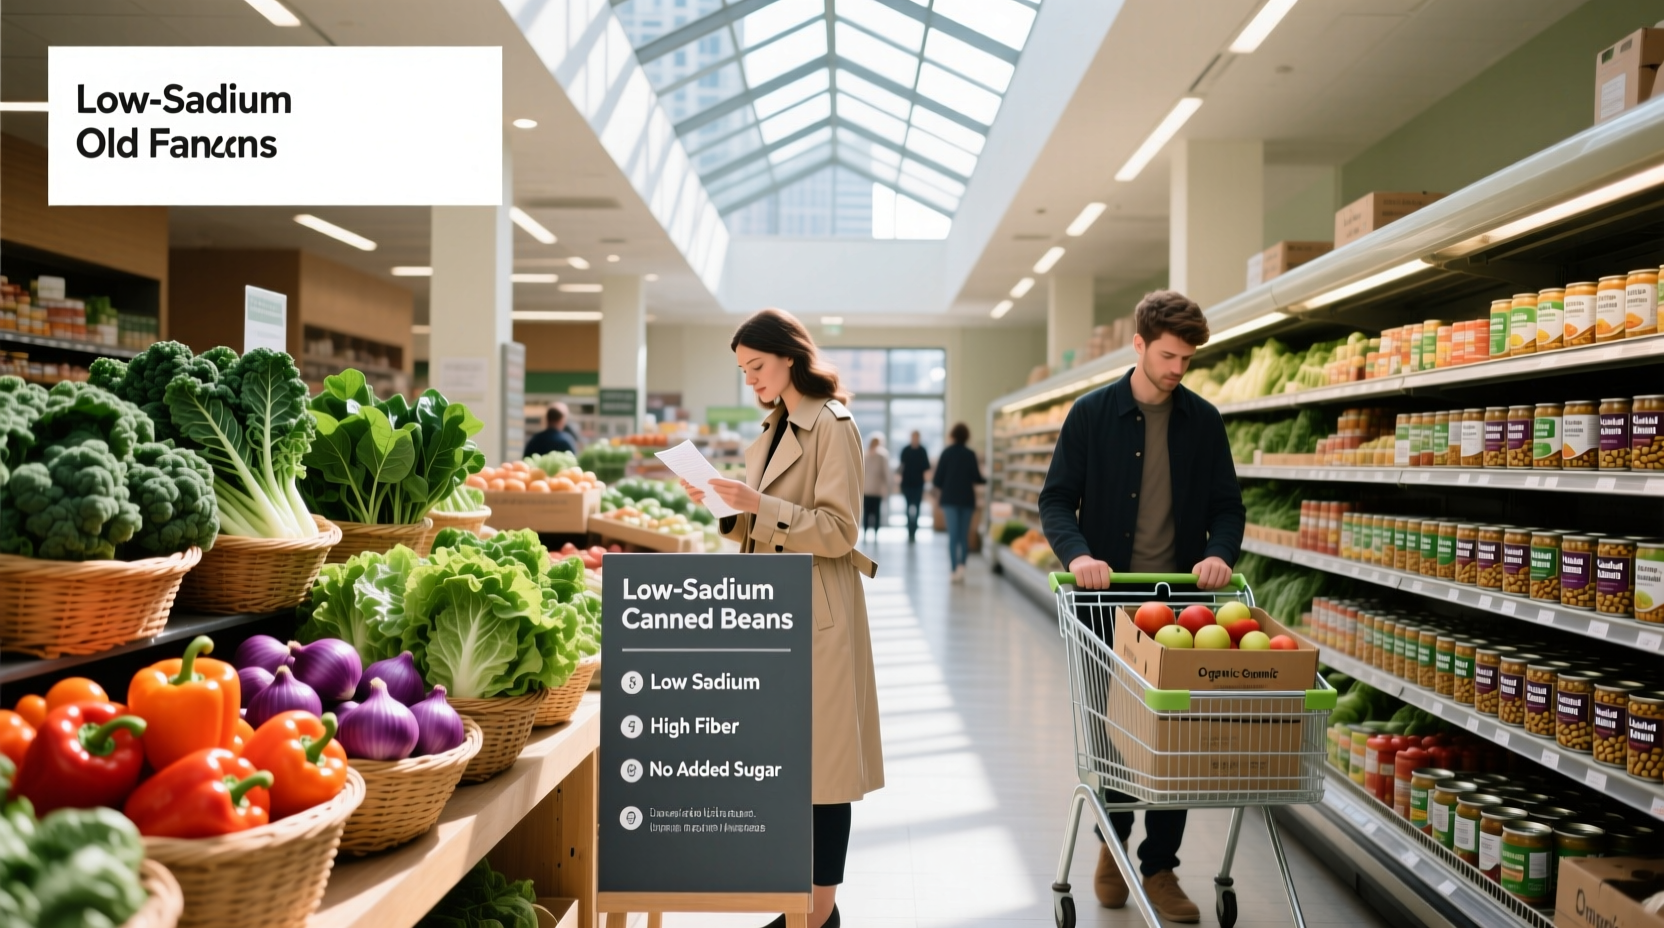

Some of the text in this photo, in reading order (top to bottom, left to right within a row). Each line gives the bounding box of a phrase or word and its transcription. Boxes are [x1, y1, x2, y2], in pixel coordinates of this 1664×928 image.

[622, 577, 774, 601] Low-Sadium
[621, 607, 794, 630] Canned Beans
[650, 673, 688, 691] Low
[692, 672, 761, 691] Sadium
[650, 717, 690, 739] High
[695, 717, 740, 735] Fiber
[649, 760, 674, 778] No
[676, 760, 730, 778] Added
[733, 760, 783, 782] Sugar
